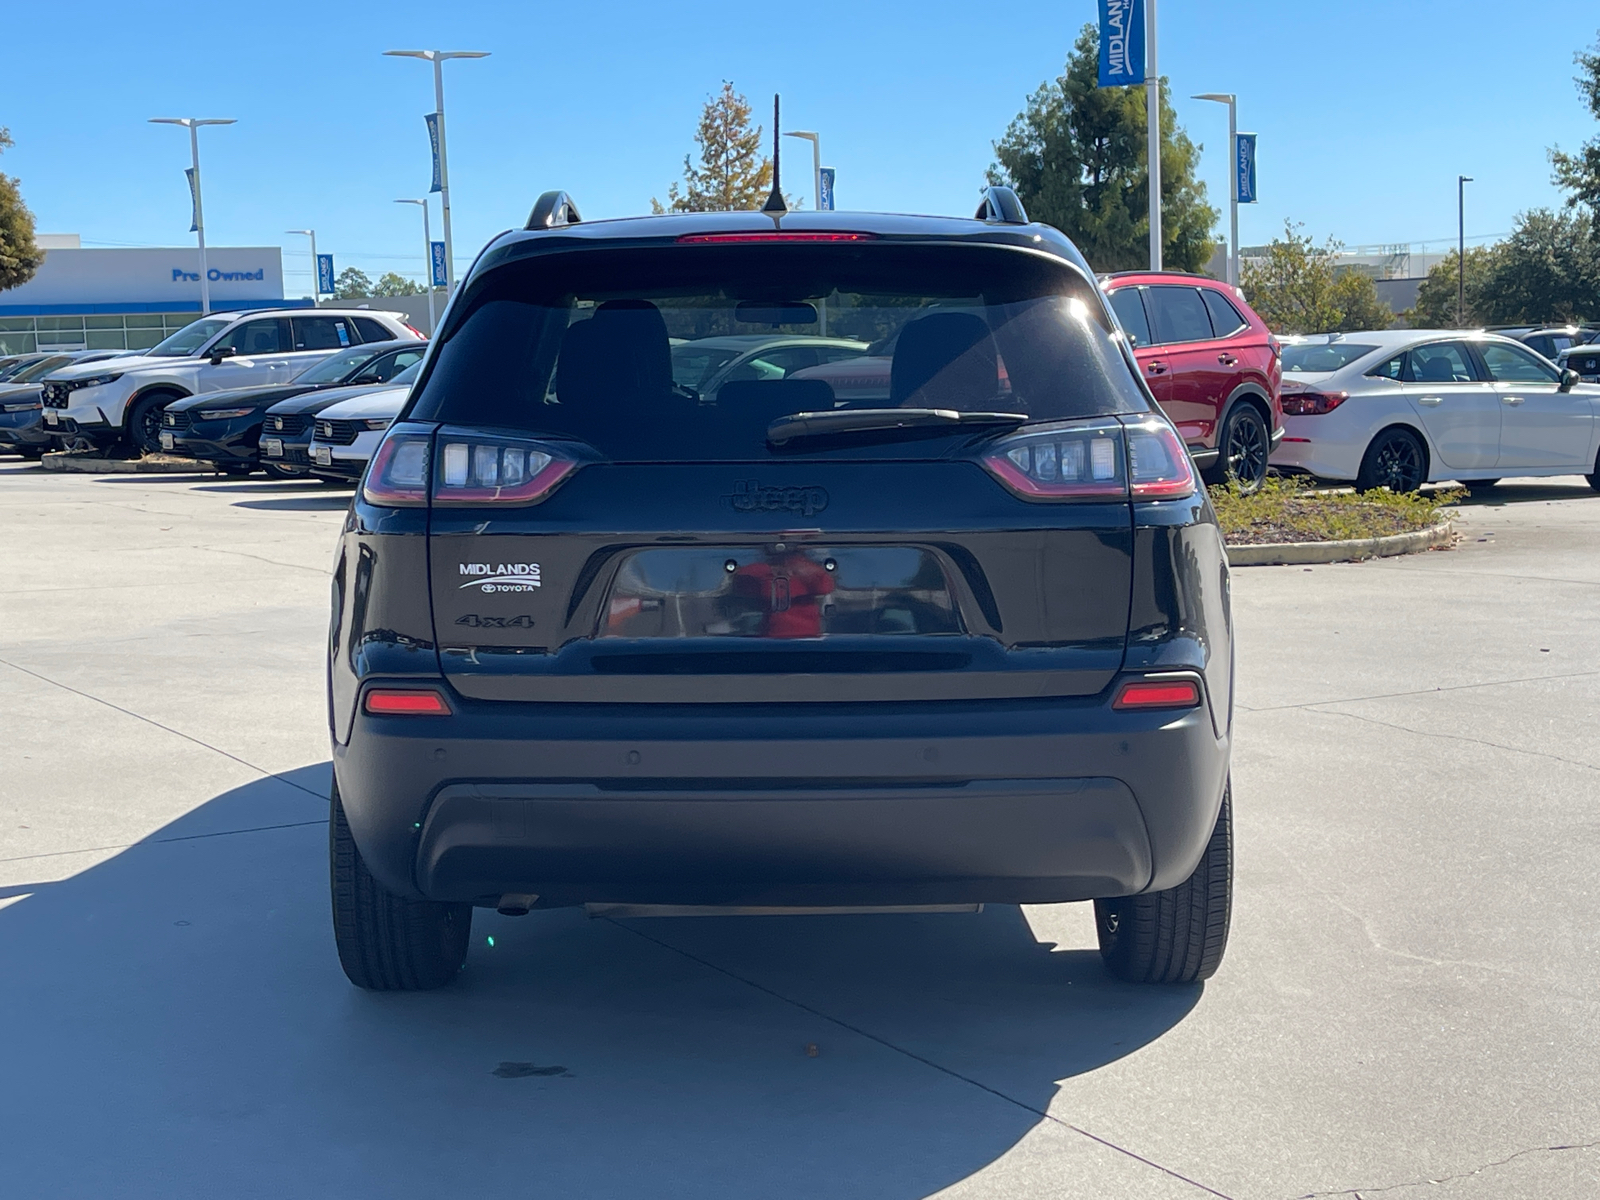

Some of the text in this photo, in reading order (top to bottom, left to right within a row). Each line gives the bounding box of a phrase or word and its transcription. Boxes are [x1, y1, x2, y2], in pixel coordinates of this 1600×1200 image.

[1107, 0, 1123, 75] MIDLAN
[1240, 138, 1248, 197] MIDLANDS
[320, 256, 328, 291] MIDLANDS
[434, 244, 443, 282] MIDLANDS
[731, 479, 829, 517] Jeep
[459, 563, 541, 575] MIDLANDS
[455, 613, 535, 629] 4x4
